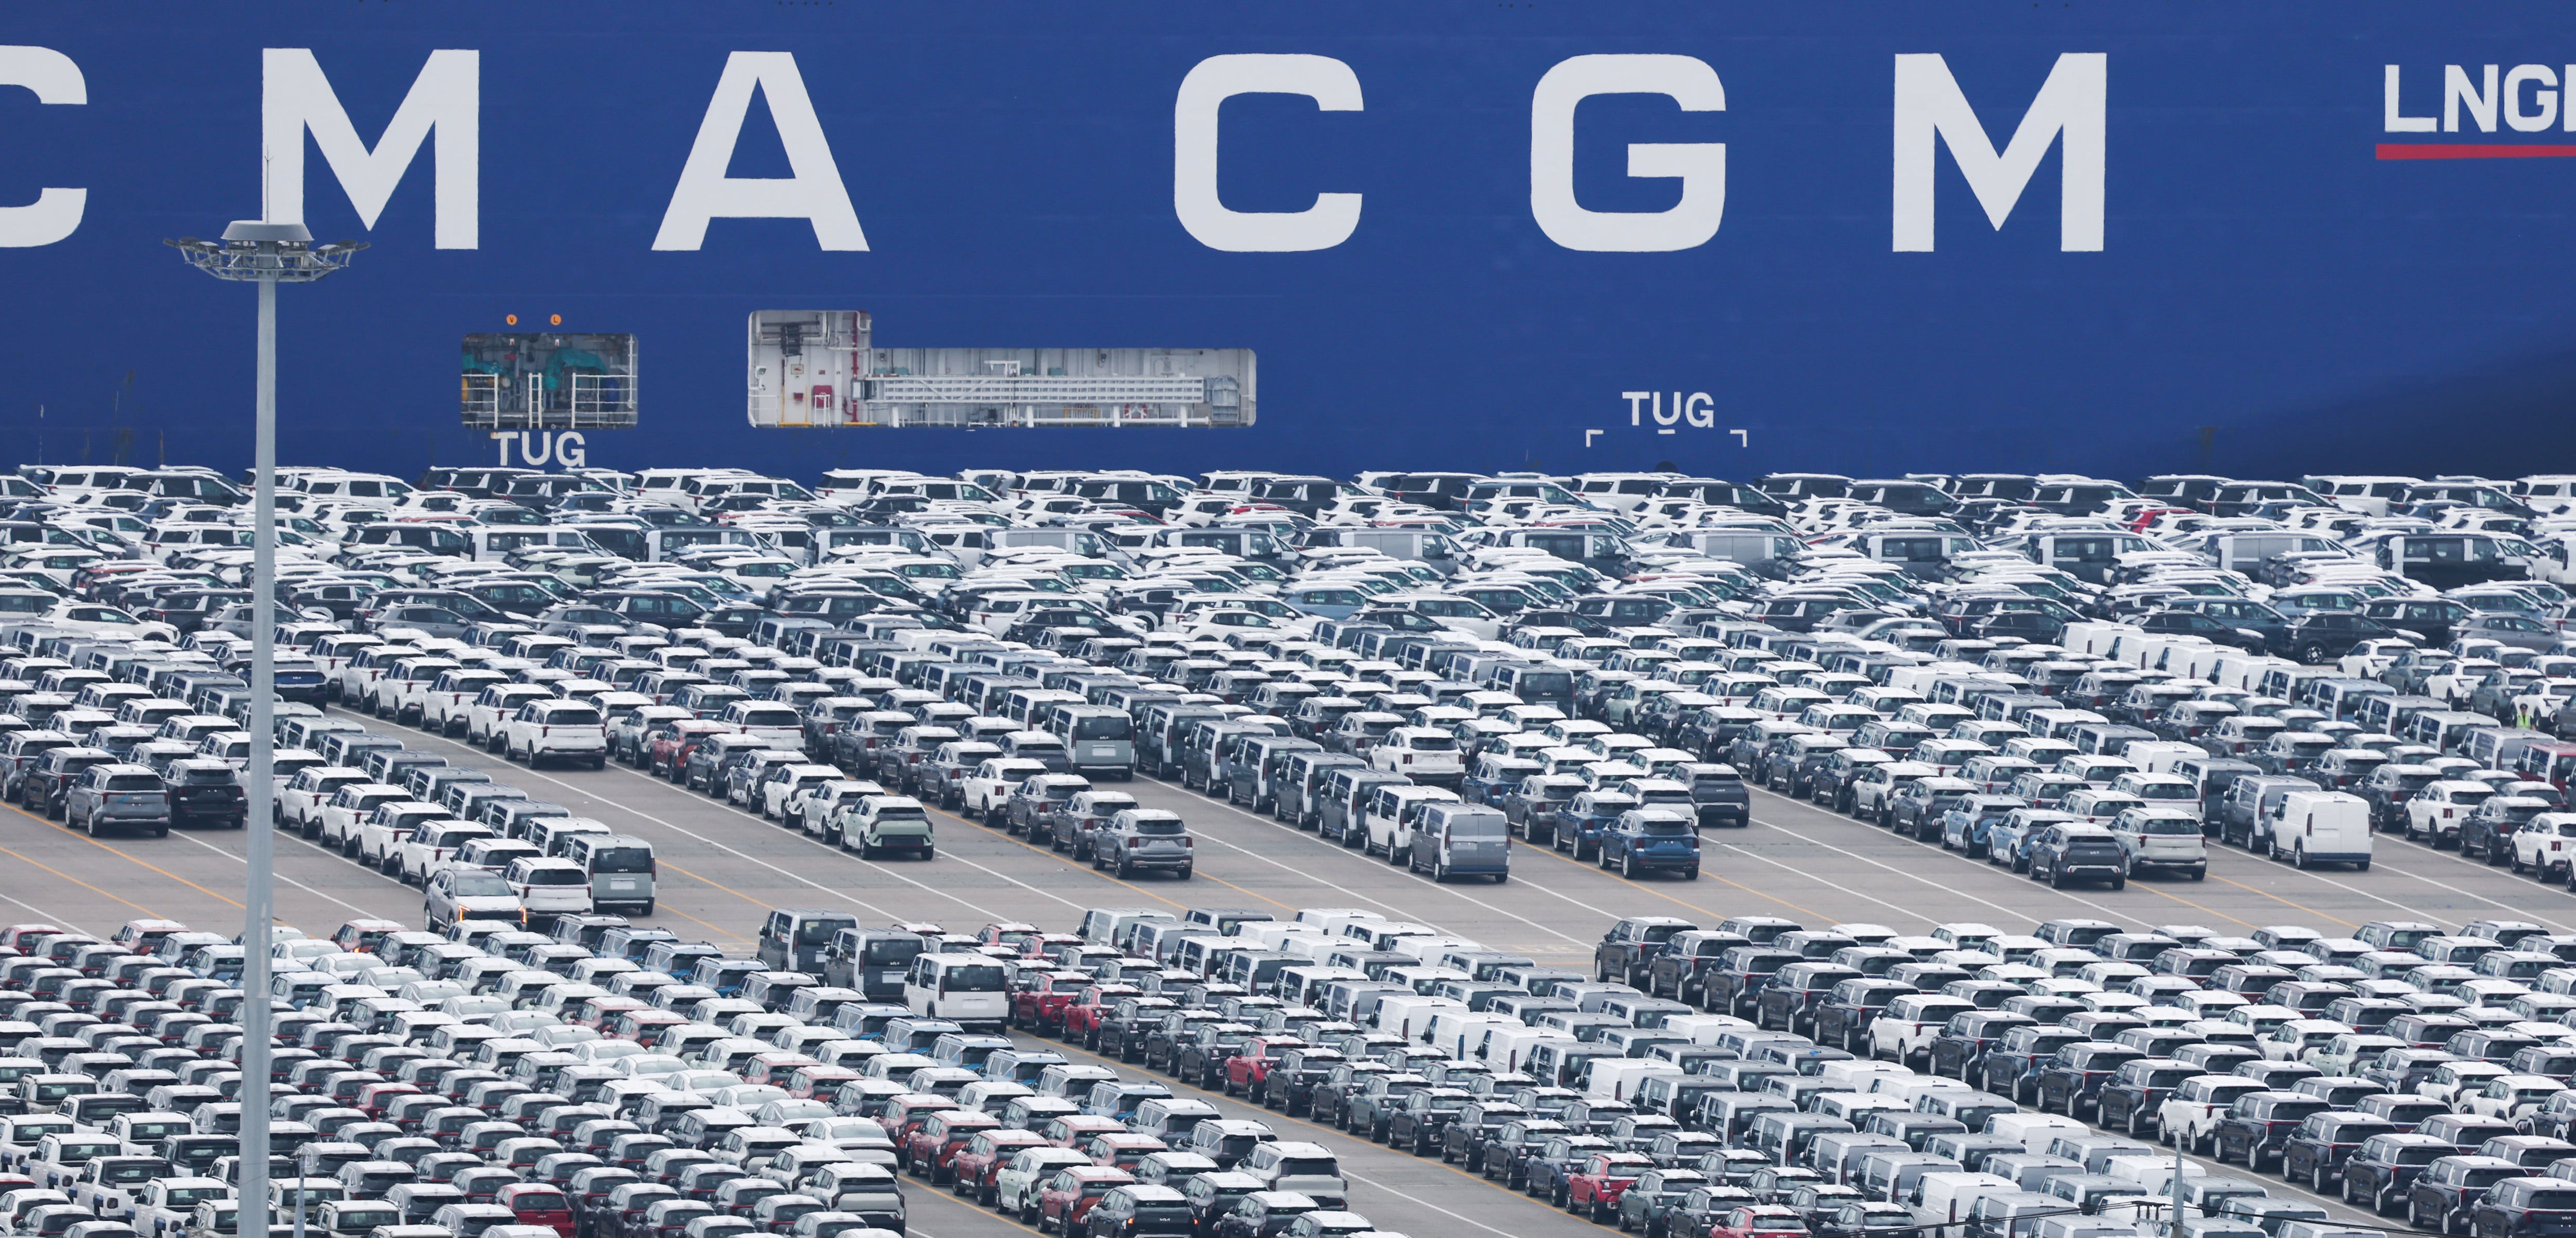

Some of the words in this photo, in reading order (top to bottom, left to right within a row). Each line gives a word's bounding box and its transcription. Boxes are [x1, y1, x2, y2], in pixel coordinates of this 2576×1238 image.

[2385, 64, 2576, 132] LNG
[1174, 53, 2107, 253] CGM
[1622, 392, 1714, 428] TUG
[490, 431, 585, 467] TUG
